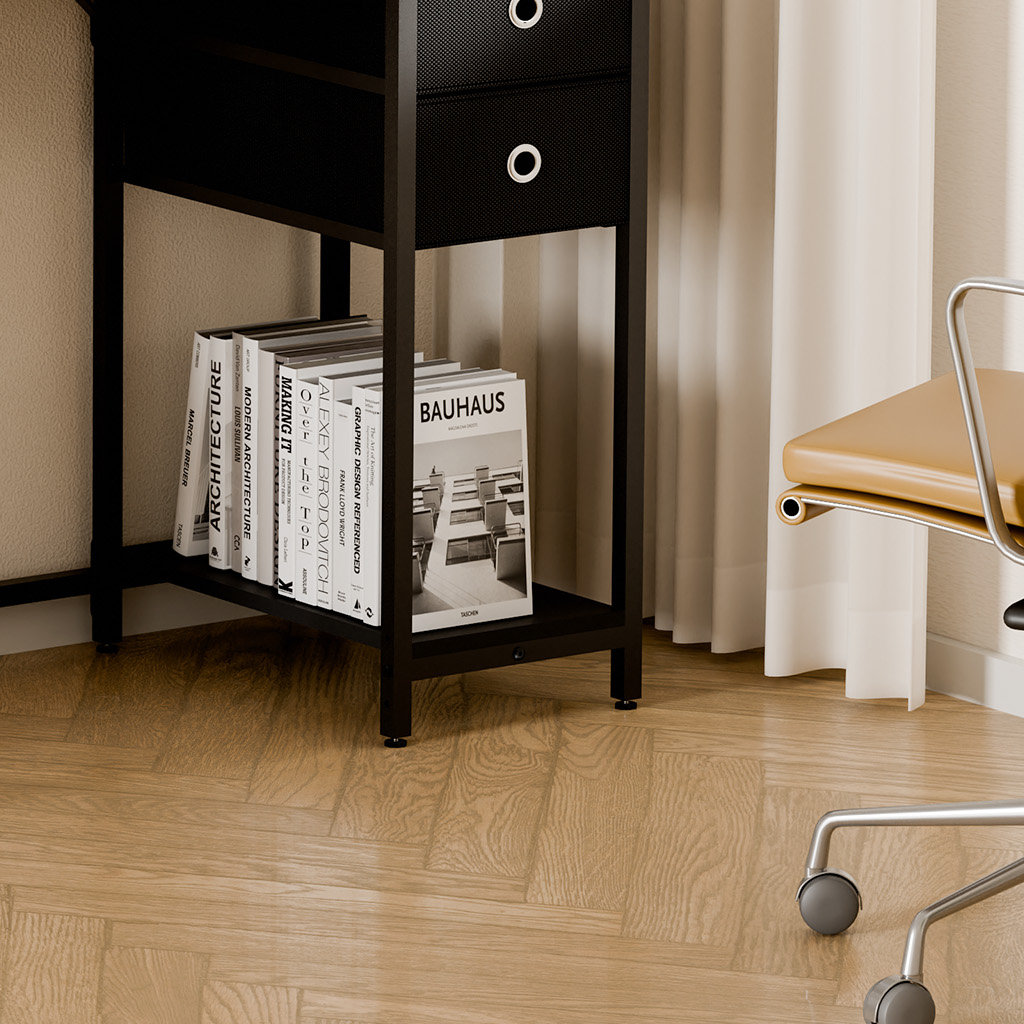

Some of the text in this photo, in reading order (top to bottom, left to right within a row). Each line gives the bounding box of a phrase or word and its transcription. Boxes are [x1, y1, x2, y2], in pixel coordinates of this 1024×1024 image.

[210, 360, 222, 532] ARCHITECTURE
[280, 376, 293, 454] MAKING IT
[300, 388, 312, 440] Over
[318, 382, 330, 461] ALEXEY
[420, 391, 505, 423] BAUHAUS
[182, 408, 195, 487] MARCEL BREUER
[244, 386, 252, 540] MODERN ARCHITECTURE
[302, 457, 310, 494] the
[318, 464, 330, 595] BRODOVITCH
[460, 610, 479, 618] TASCHEN
